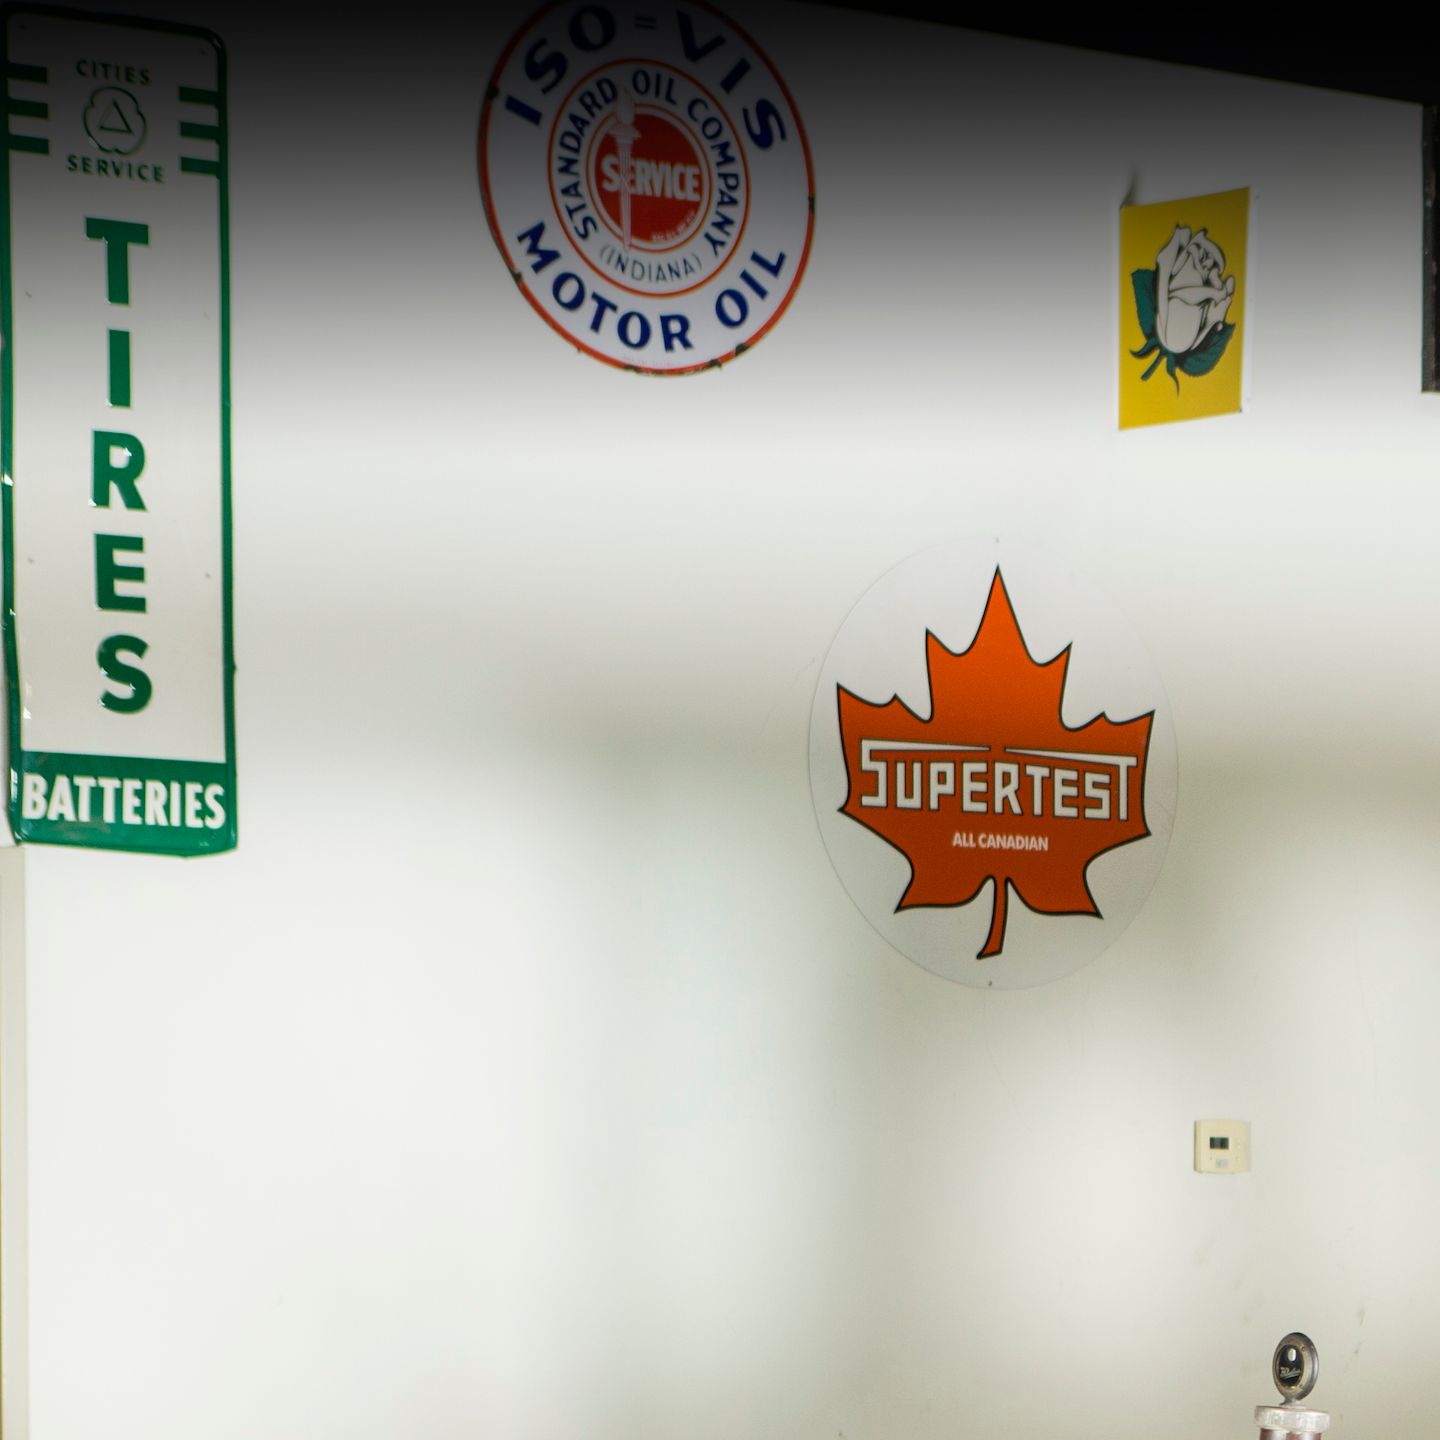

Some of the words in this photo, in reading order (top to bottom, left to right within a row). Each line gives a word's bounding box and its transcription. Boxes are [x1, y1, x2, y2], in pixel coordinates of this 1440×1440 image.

[76, 60, 151, 85] CITIES
[67, 155, 164, 183] SERVICE
[558, 77, 619, 241] STANDARD
[632, 69, 677, 105] OIL
[687, 98, 741, 256] COMPANY
[600, 153, 701, 202] SERVICE
[517, 220, 694, 352] MOTOR
[715, 250, 787, 329] OIL
[83, 216, 153, 716] TIRES
[21, 772, 227, 831] BATTERIES
[860, 738, 1138, 821] SUPERTEST
[952, 832, 976, 849] ALL
[978, 833, 1049, 851] CANADIAN
